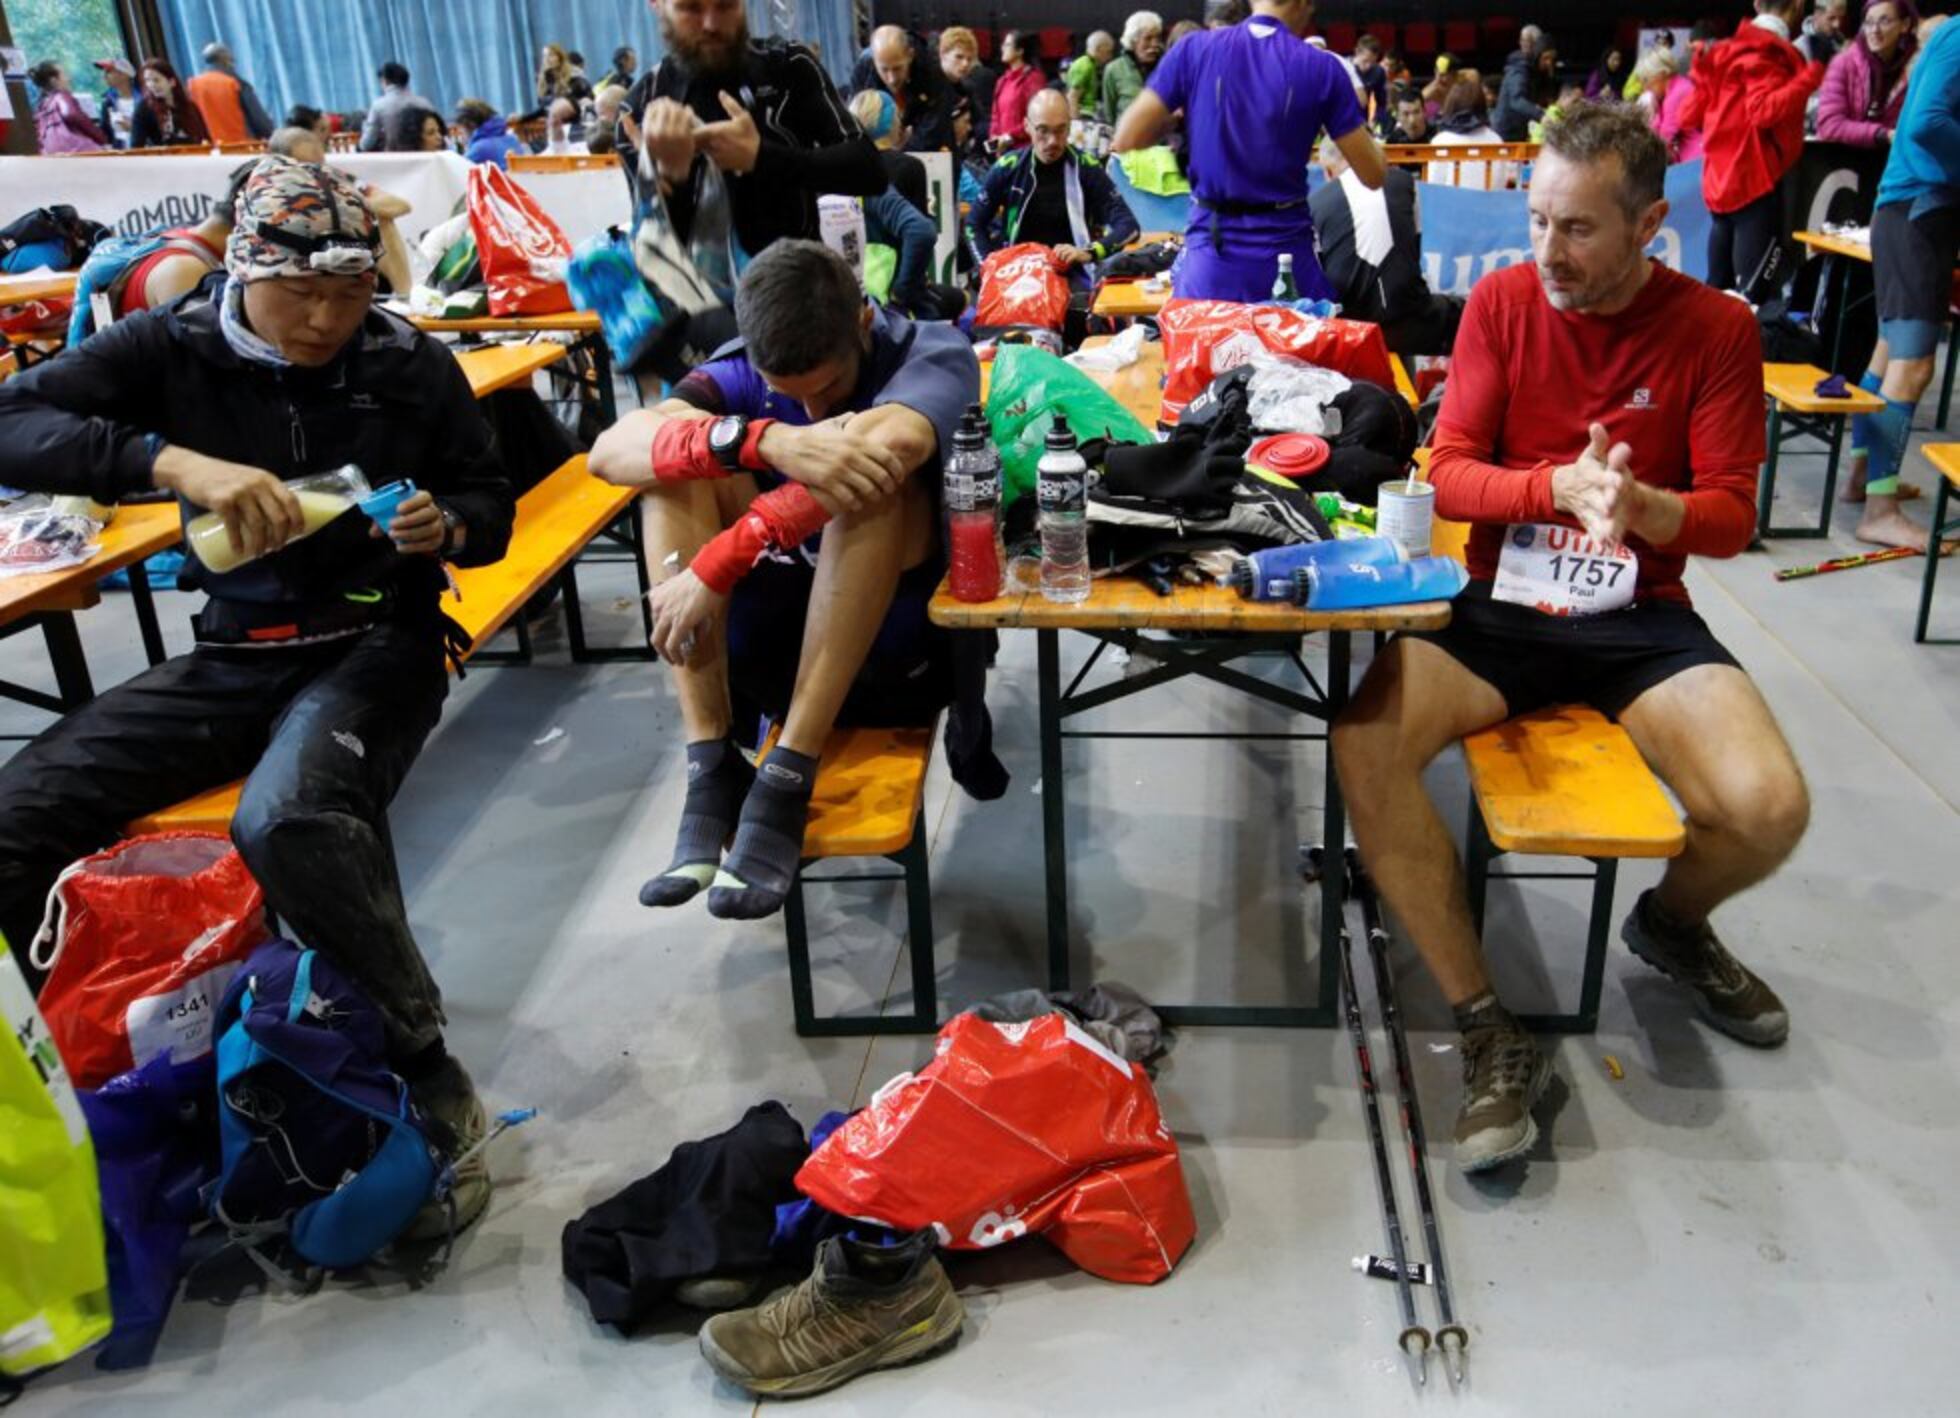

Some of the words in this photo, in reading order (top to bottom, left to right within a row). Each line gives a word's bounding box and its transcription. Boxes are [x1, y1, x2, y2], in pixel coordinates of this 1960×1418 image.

[1549, 554, 1626, 589] 1757
[1569, 585, 1596, 598] Paul
[166, 993, 209, 1020] 1341
